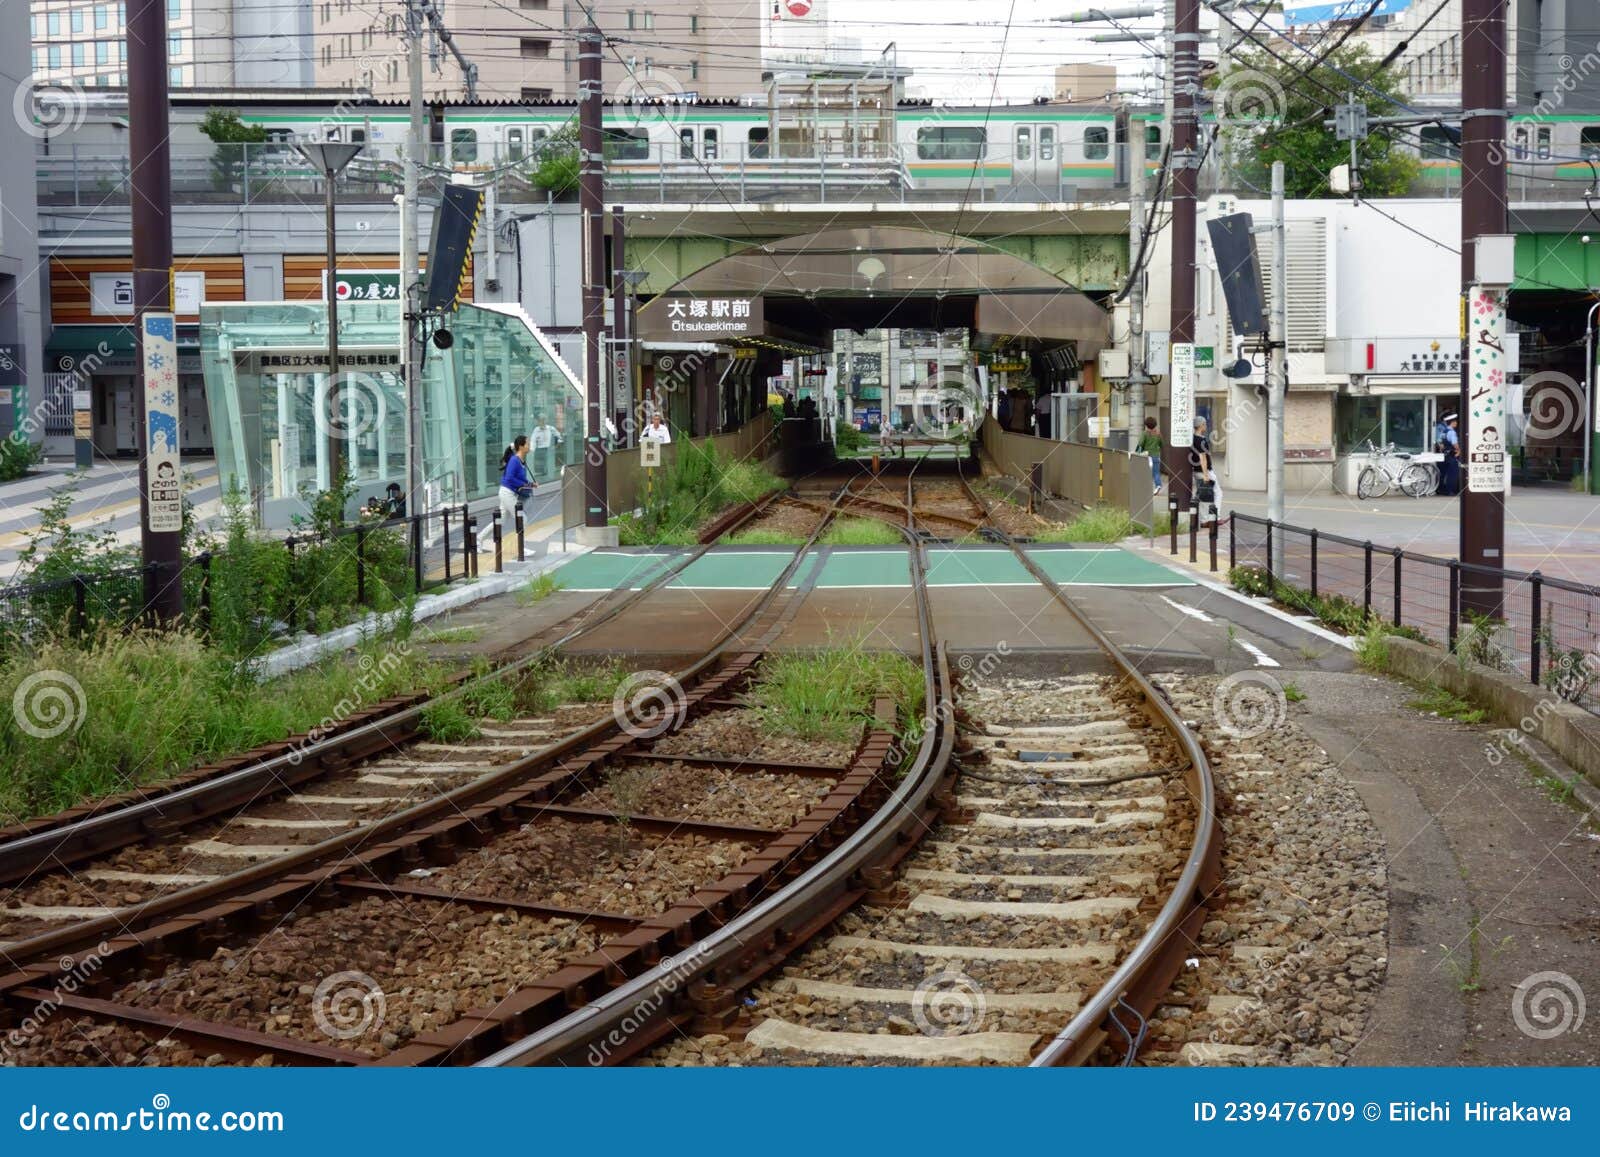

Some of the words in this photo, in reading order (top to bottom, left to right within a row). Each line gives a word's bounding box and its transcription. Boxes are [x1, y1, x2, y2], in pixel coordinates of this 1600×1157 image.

[353, 283, 401, 300] 乃屋カ
[667, 300, 751, 318] 大塚駅前
